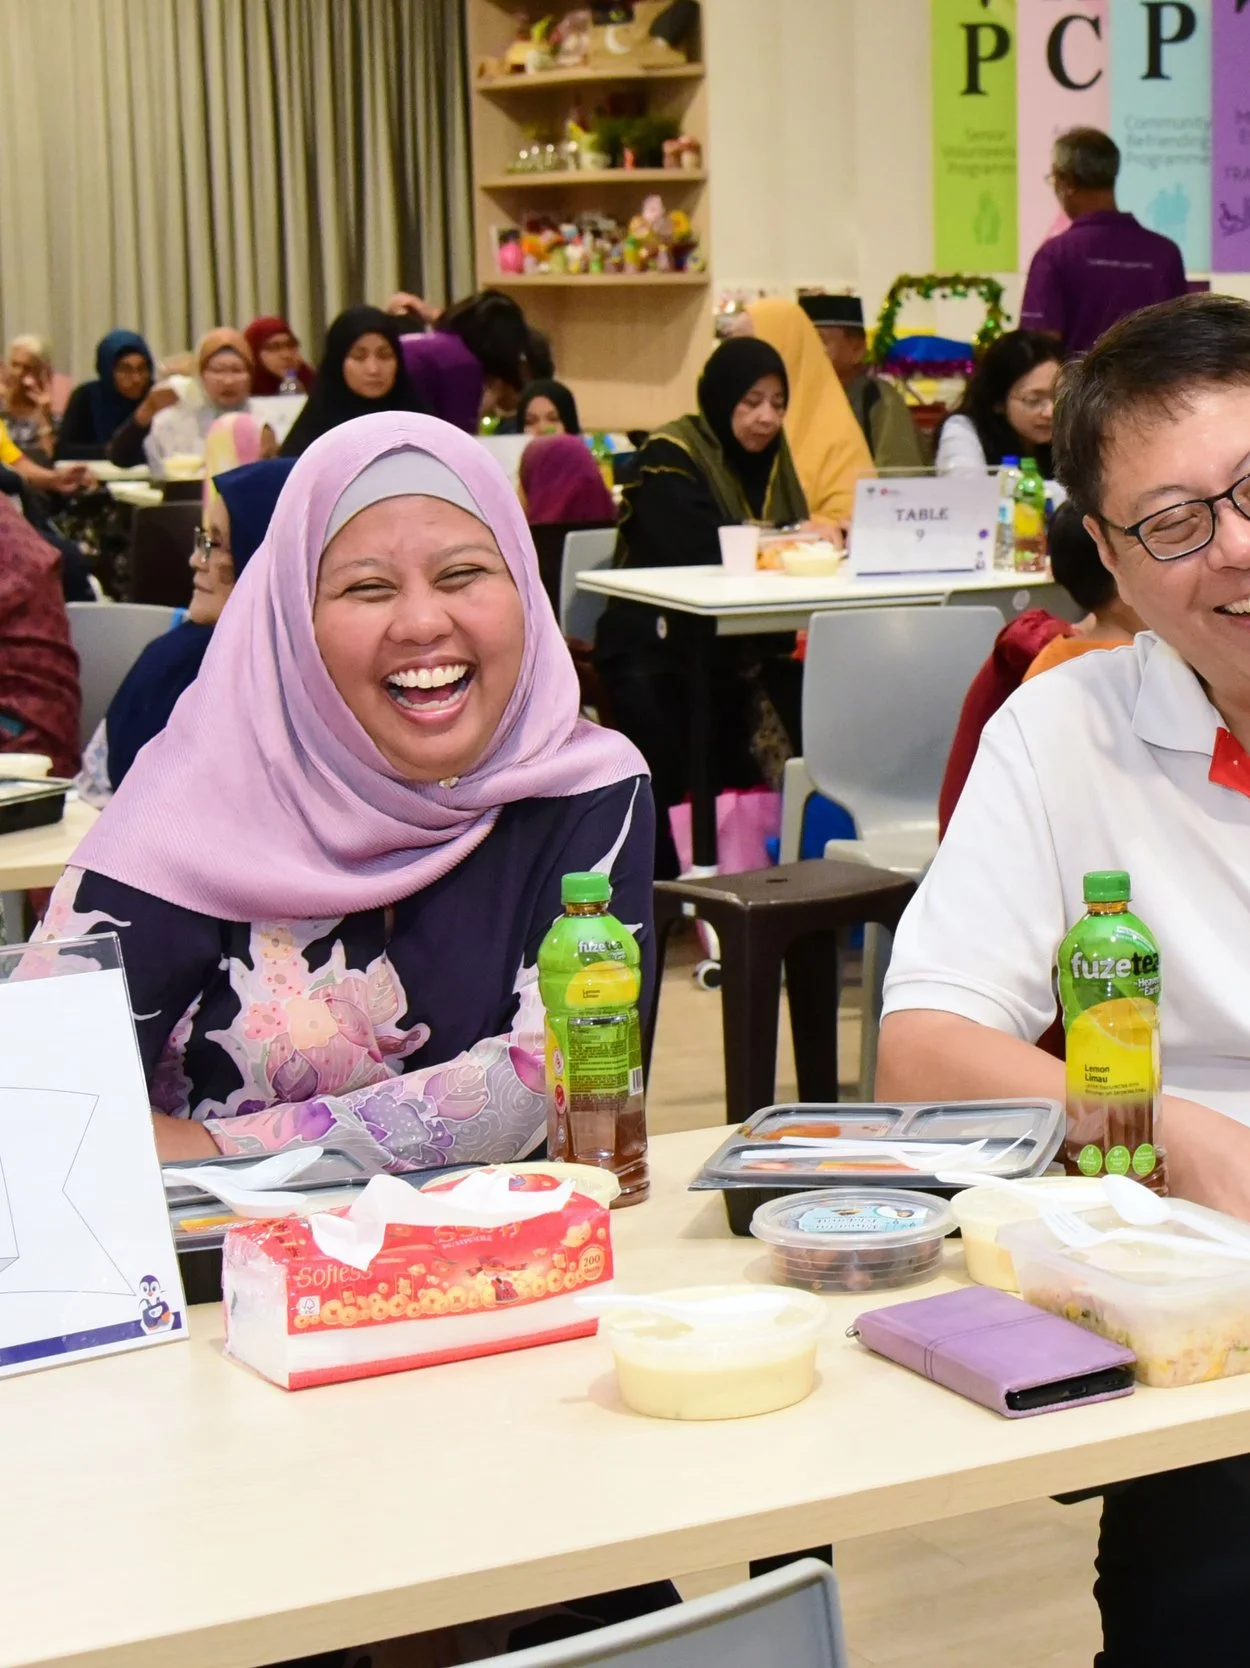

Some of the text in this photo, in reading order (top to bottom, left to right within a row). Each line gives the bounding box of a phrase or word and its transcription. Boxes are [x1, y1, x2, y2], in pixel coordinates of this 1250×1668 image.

[1140, 1, 1197, 80] P
[960, 22, 1011, 96] P
[1046, 14, 1103, 91] C
[896, 507, 949, 521] TABLE
[1071, 951, 1159, 980] fuzetea
[1084, 1063, 1111, 1074] Lemon
[1084, 1073, 1108, 1084] Limau
[583, 1254, 601, 1268] 200
